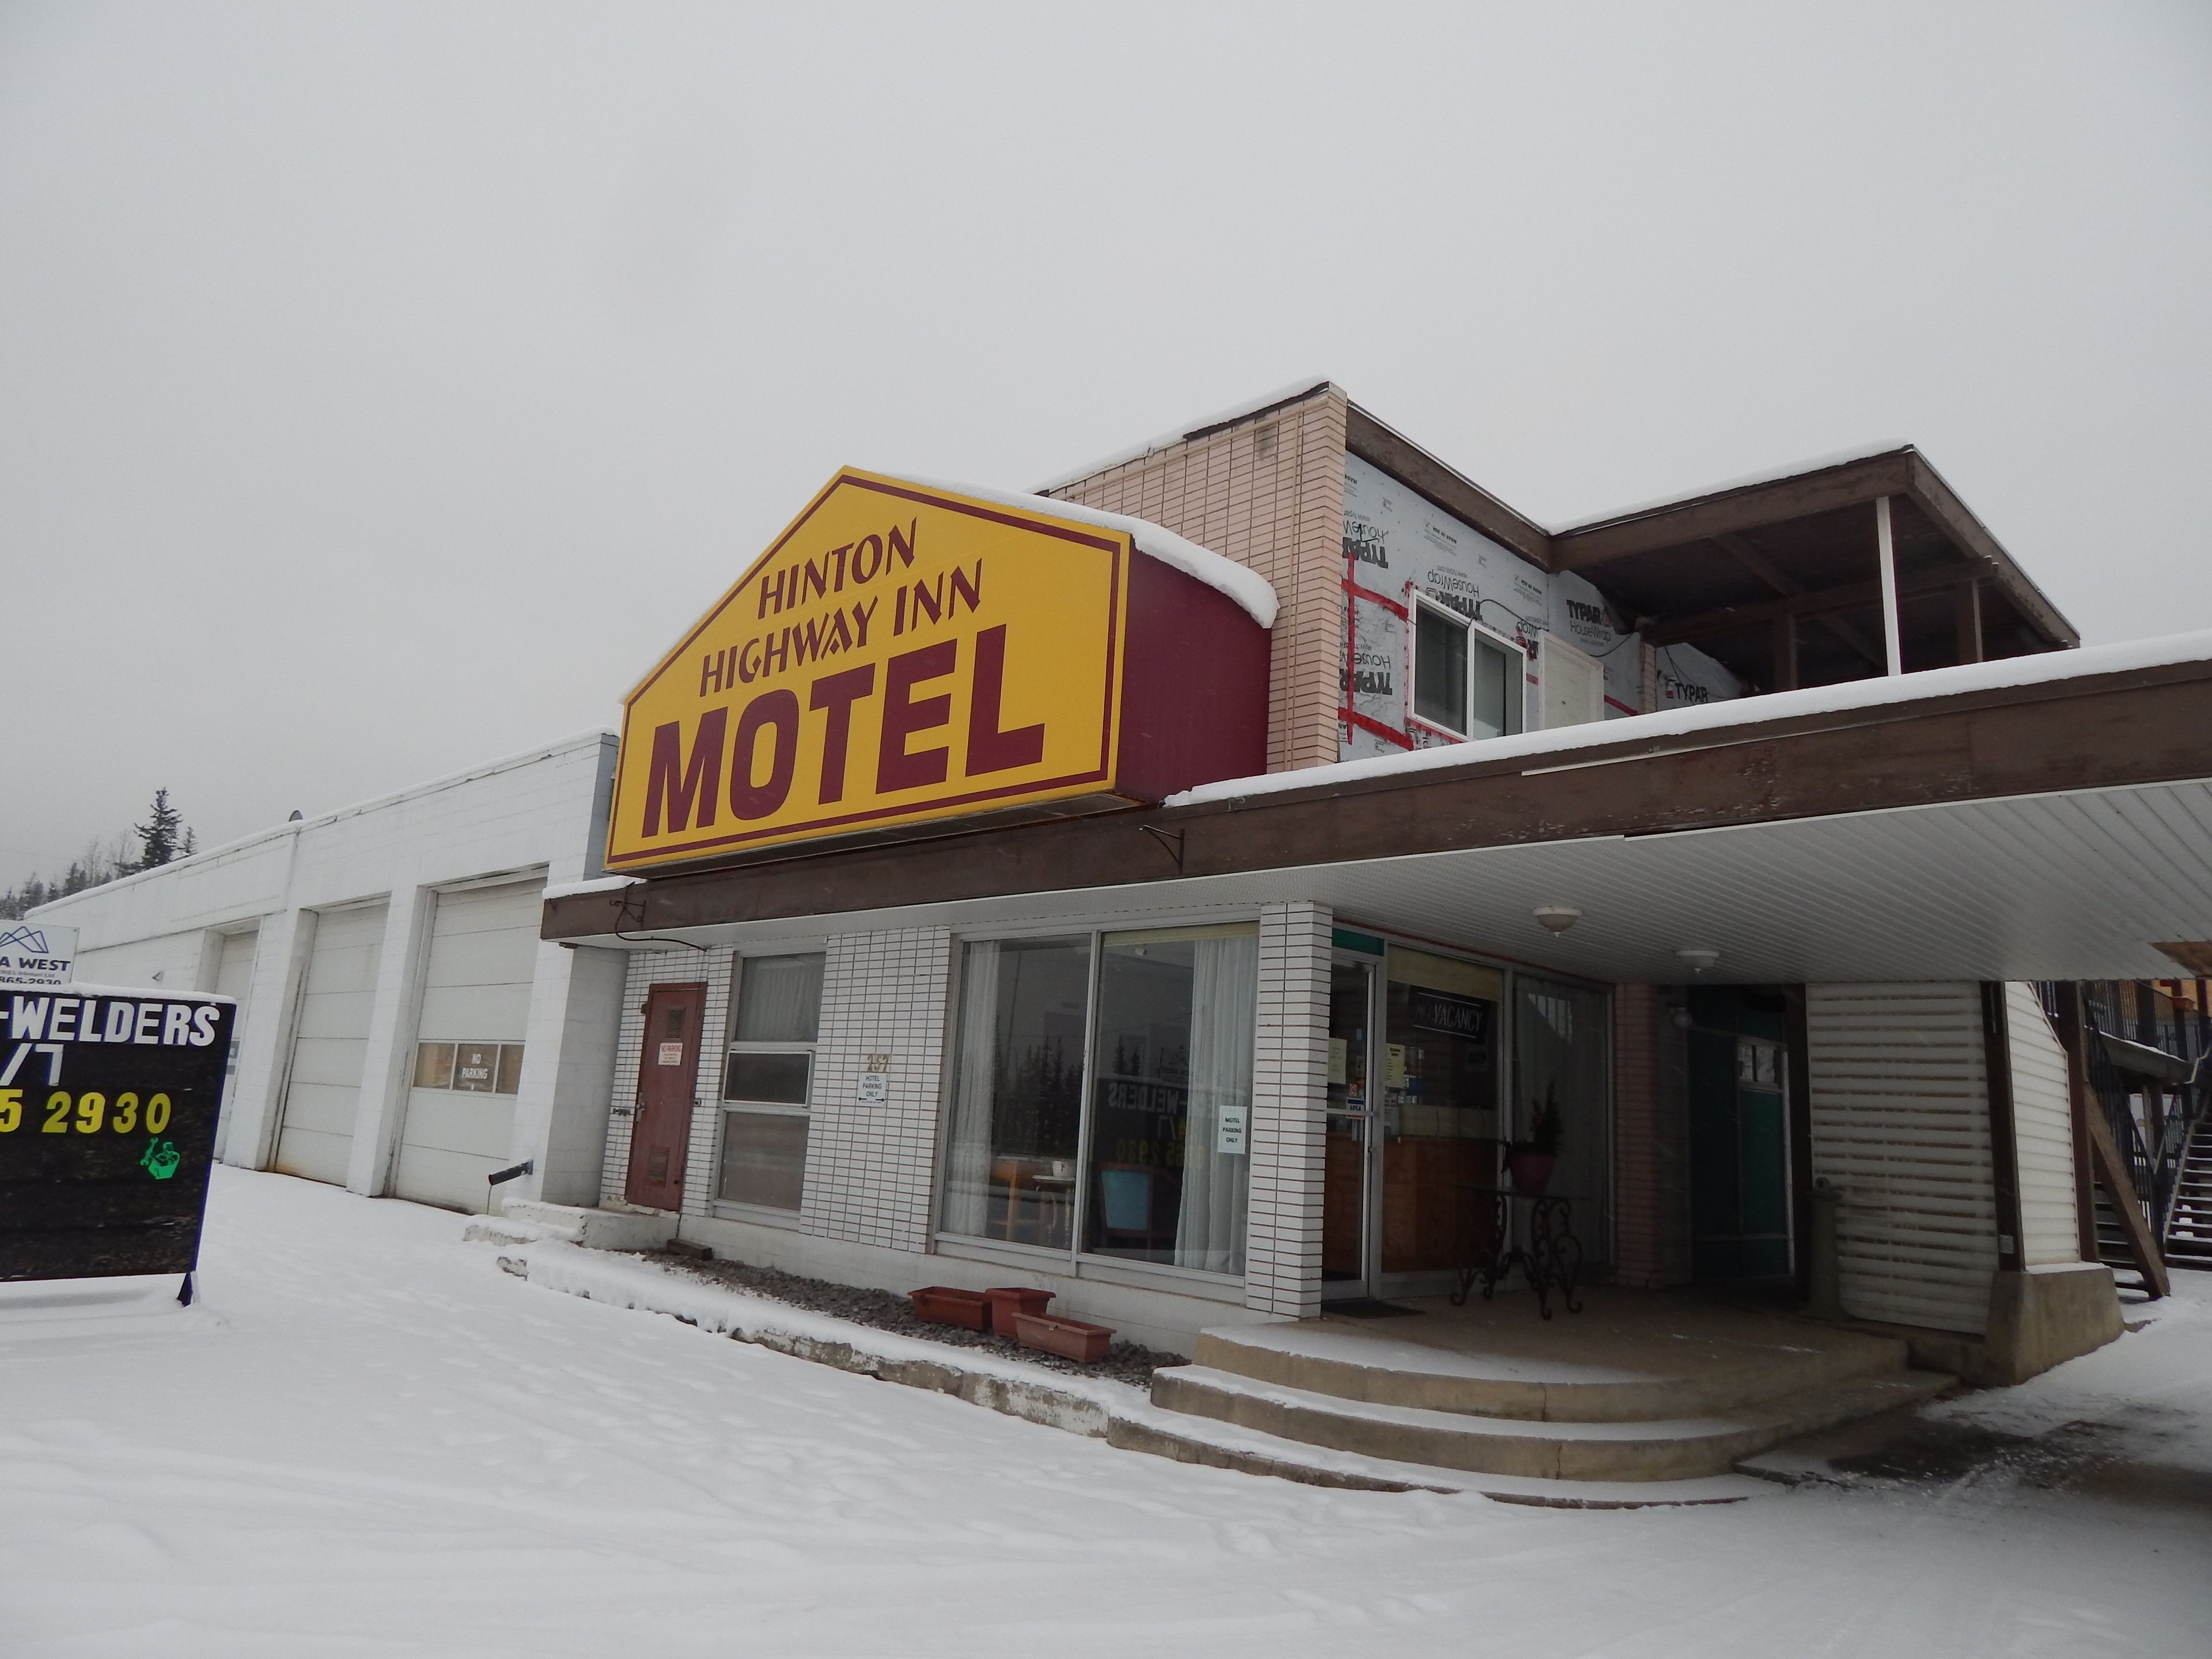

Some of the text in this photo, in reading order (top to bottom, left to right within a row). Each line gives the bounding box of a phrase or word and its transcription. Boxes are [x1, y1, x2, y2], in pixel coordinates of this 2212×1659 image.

[758, 517, 916, 620] HINTON
[1427, 569, 1479, 599] HouseWrap
[700, 558, 982, 696] HIGHWAY INN
[1566, 600, 1601, 625] TYPAR
[1675, 683, 1708, 703] TYPAR
[641, 624, 1044, 838] MOTEL
[19, 957, 71, 971] WEST
[1434, 1003, 1482, 1032] VACANCY
[462, 1067, 488, 1079] PARKING
[471, 1054, 482, 1065] NO
[0, 1089, 171, 1134] 5 2930
